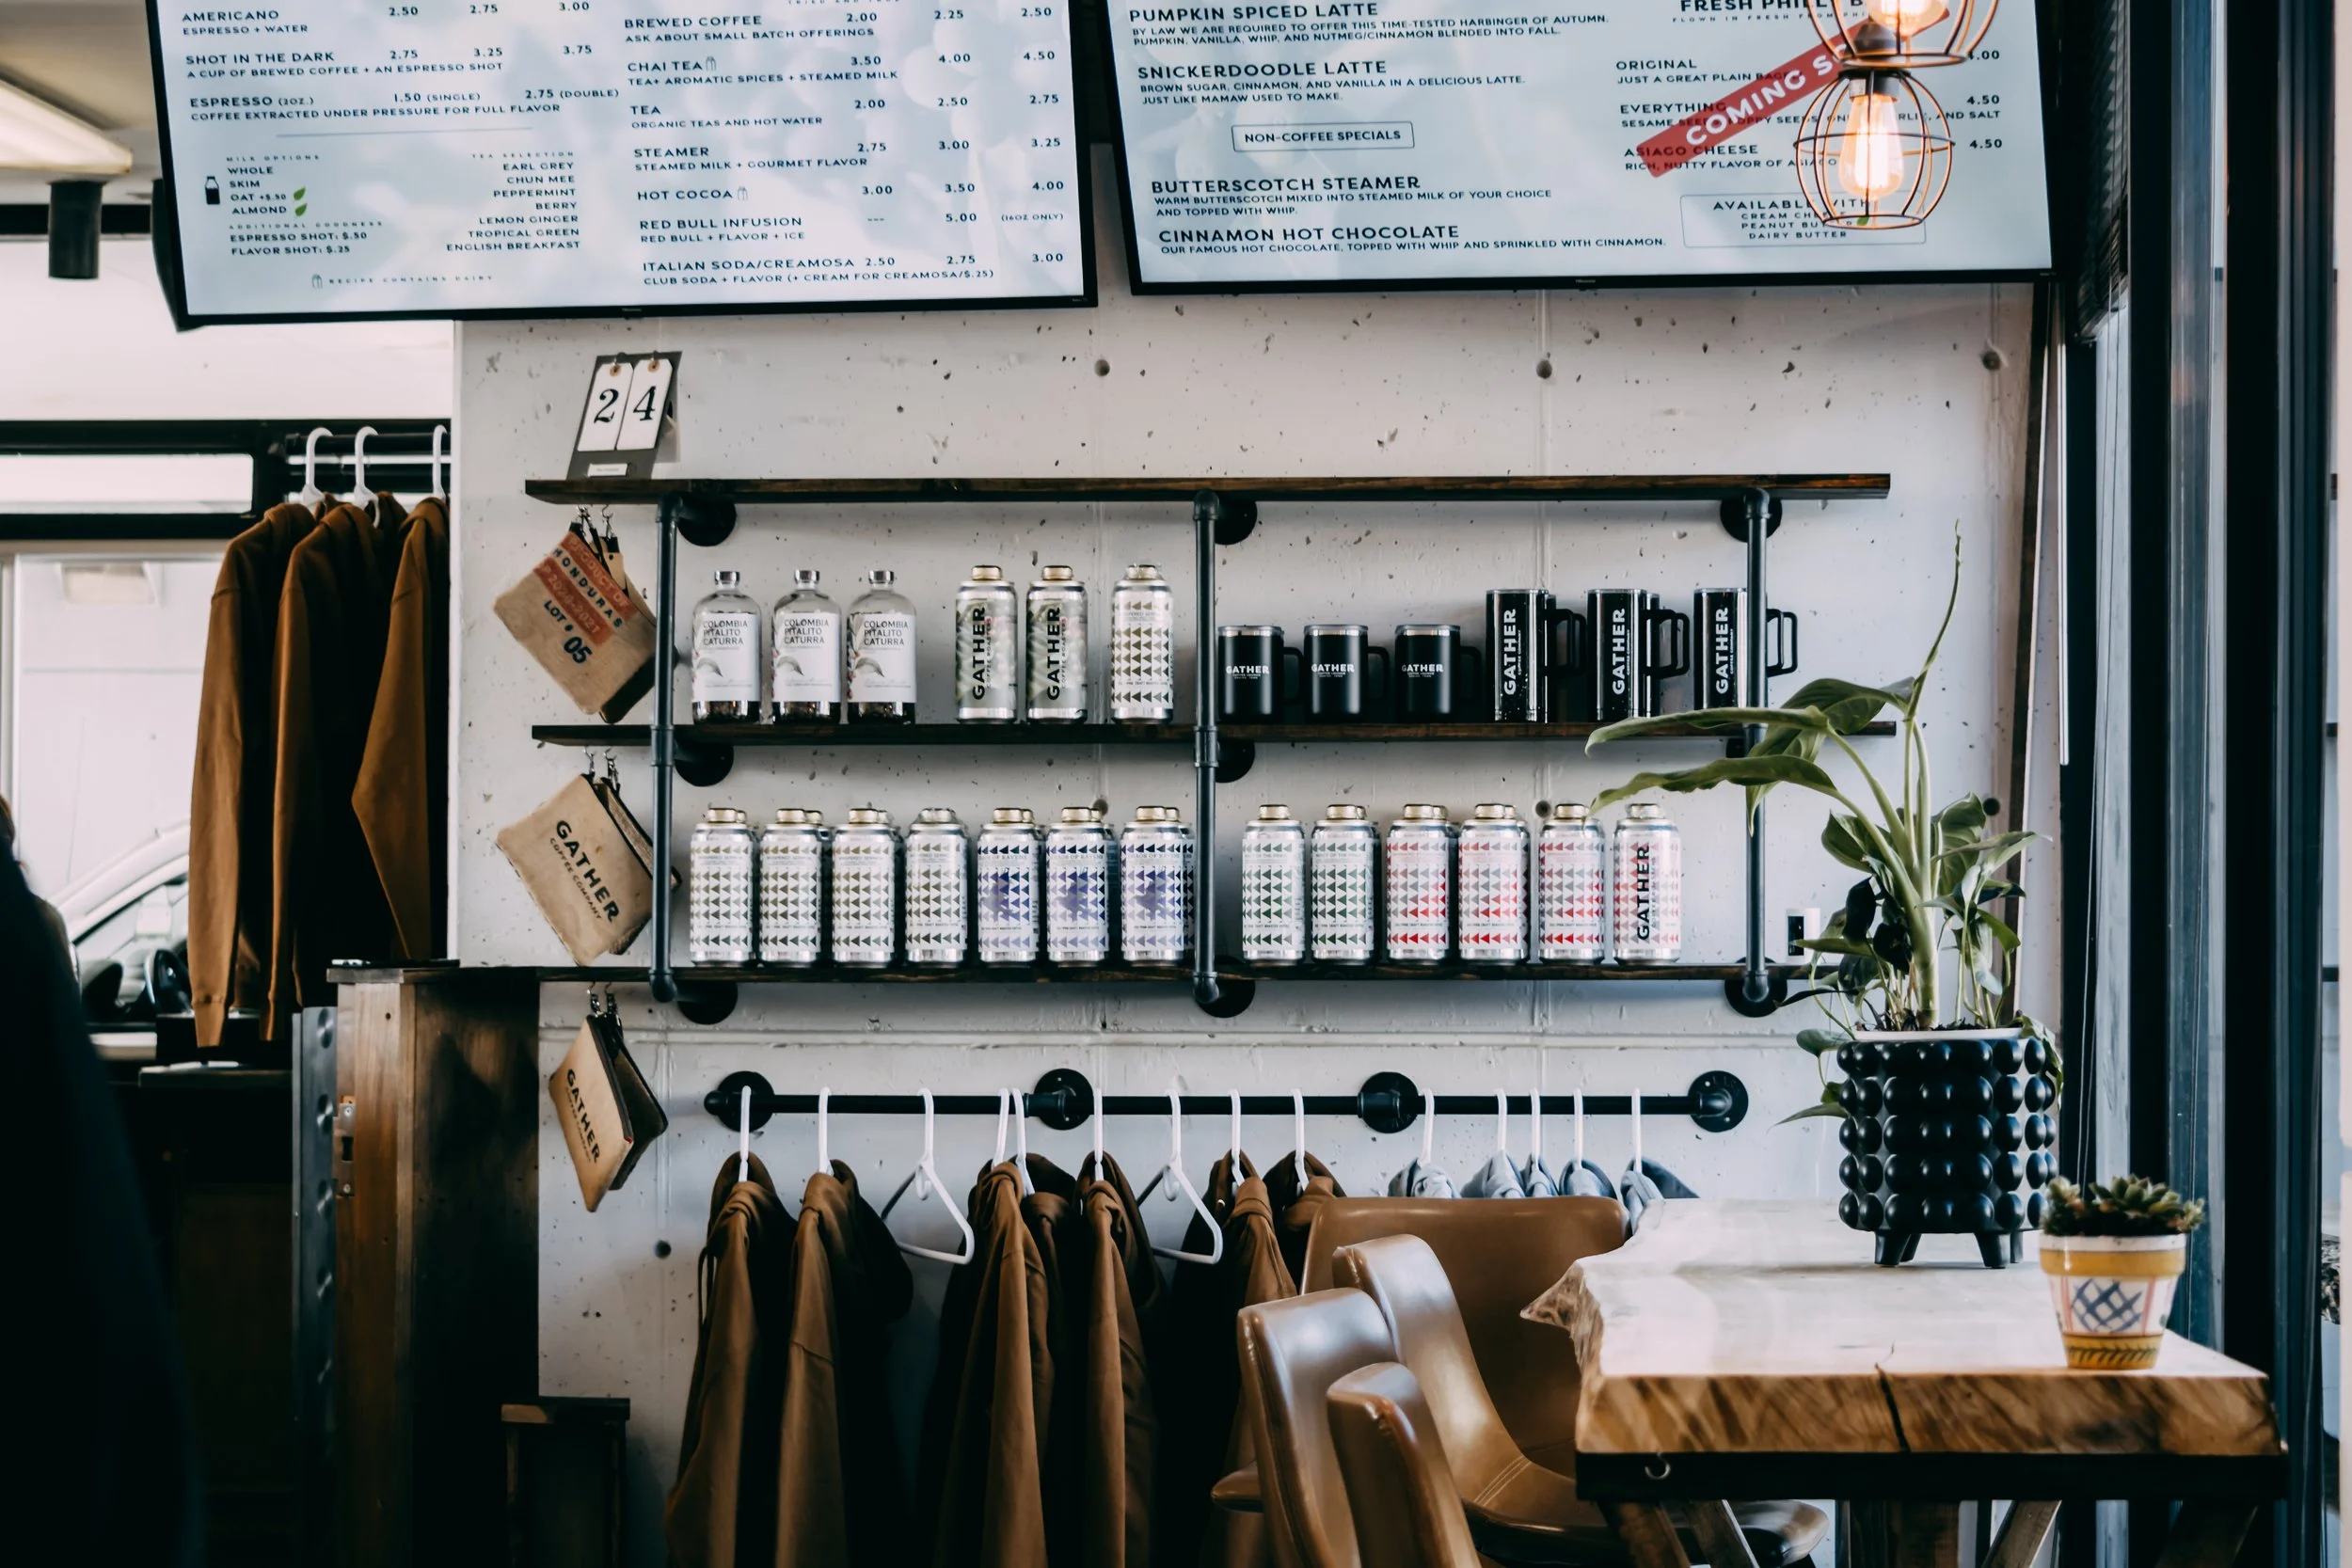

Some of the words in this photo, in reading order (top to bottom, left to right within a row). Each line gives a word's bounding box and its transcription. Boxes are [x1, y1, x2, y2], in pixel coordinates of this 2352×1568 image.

[181, 8, 279, 22] AMERICANO
[388, 5, 419, 17] 2.50
[469, 3, 499, 14] 2.75
[559, 0, 590, 11] 3.00
[1128, 6, 1225, 23] PUMPKIN
[1232, 4, 1308, 20] SPICED
[1314, 1, 1378, 17] LATTE
[1680, 0, 1754, 12] FRESH
[623, 16, 692, 29] BREWED
[697, 14, 762, 26] COFFEE
[845, 11, 878, 23] 2.00
[933, 8, 964, 20] 2.25
[1021, 6, 1052, 17] 2.50
[625, 34, 651, 42] ASK
[654, 32, 699, 42] ABOUT
[703, 31, 748, 40] SMALL
[751, 29, 795, 40] BATCH
[798, 27, 874, 38] OFFERINGS
[184, 54, 227, 65] SHOT
[232, 53, 250, 64] IN
[254, 52, 286, 63] THE
[291, 51, 335, 62] DARK
[389, 48, 419, 60] 2.75
[473, 46, 503, 57] 3.25
[563, 43, 593, 55] 3.75
[627, 60, 666, 72] CHAI
[670, 59, 703, 71] TEA
[850, 55, 882, 66] 3.50
[937, 52, 971, 64] 4.00
[1022, 50, 1056, 61] 4.50
[1136, 61, 1316, 80] SNICKERDOODLE
[1323, 59, 1387, 75] LATTE
[1614, 57, 1697, 71] ORIGINAL
[1616, 74, 1648, 85] JUST
[1665, 72, 1708, 83] GREAT
[1711, 71, 1752, 82] PLAIN
[189, 96, 273, 107] ESPRESSO
[393, 91, 421, 103] 1.50
[425, 91, 481, 103] (SINGLE)
[524, 87, 554, 100] 2.75
[558, 87, 619, 99] (DOUBLE)
[629, 104, 661, 116] TEA
[853, 98, 885, 109] 2.00
[937, 96, 968, 107] 2.50
[1028, 92, 1059, 104] 2.75
[1141, 95, 1169, 104] JUST
[1172, 94, 1196, 104] LIKE
[1200, 93, 1248, 103] MAMAW
[1251, 92, 1283, 103] USED
[1286, 92, 1303, 102] TO
[1619, 103, 1727, 115] EVERYTHING
[1965, 93, 2000, 105] 4.50
[190, 111, 240, 121] COFFEE
[244, 109, 320, 120] EXTRACTED
[323, 107, 368, 118] UNDER
[372, 106, 439, 117] PRESSURE
[443, 105, 469, 115] FOR
[473, 104, 504, 114] FULL
[509, 103, 561, 113] FLAVOR
[1686, 70, 1806, 146] COMING
[1621, 119, 1675, 128] SESAME
[1968, 110, 2001, 120] SALT
[1244, 131, 1334, 143] NON-COFFEE
[1336, 129, 1401, 141] SPECIALS
[632, 146, 709, 158] STEAMER
[856, 141, 886, 152] 2.75
[938, 139, 970, 150] 3.00
[1030, 136, 1061, 148] 3.25
[1692, 144, 1759, 156] CHEESE
[1968, 137, 2003, 150] 4.50
[226, 165, 273, 175] WHOLE
[501, 162, 534, 171] EARL
[539, 161, 574, 170] GREY
[1710, 159, 1762, 169] FLAVOR
[1766, 159, 1783, 168] OF
[228, 179, 261, 189] SKIM
[505, 175, 544, 184] CHUN
[547, 174, 575, 183] MEE
[1150, 177, 1314, 194] BUTTERSCOTCH
[1321, 175, 1421, 190] STEAMER
[492, 187, 575, 198] PEPPERMINT
[636, 189, 670, 201] HOT
[675, 188, 733, 200] COCOA
[862, 184, 893, 196] 3.00
[944, 182, 976, 193] 3.50
[1031, 180, 1064, 191] 4.00
[230, 205, 287, 214] ALMOND
[534, 200, 577, 211] BERRY
[1155, 207, 1182, 217] AND
[1184, 206, 1230, 216] TOPPED
[1232, 206, 1263, 215] WITH
[639, 218, 672, 230] RED
[675, 217, 718, 230] BULL
[723, 216, 802, 228] INFUSION
[945, 212, 977, 223] 5.00
[1740, 212, 1788, 220] CREAM
[1157, 228, 1274, 243] CINNAMON
[1281, 227, 1325, 241] HOT
[1330, 224, 1459, 240] CHOCOLATE
[1740, 222, 1795, 230] PEANUT
[1748, 231, 1789, 240] DAIRY
[1795, 230, 1848, 240] BUTTER
[445, 242, 502, 251] ENGLISH
[505, 240, 580, 250] BREAKFAST
[642, 260, 706, 272] ITALIAN
[710, 257, 854, 270] SODA/CREAMOSA
[865, 256, 896, 267] 2.50
[946, 254, 976, 264] 2.75
[1031, 251, 1063, 262] 3.00
[553, 548, 623, 627] HONDURAS
[544, 600, 566, 622] LOT
[564, 636, 593, 663] 05
[703, 619, 748, 628] COLOMBIA
[784, 619, 830, 628] COLOMBIA
[864, 620, 909, 629] COLOMBIA
[703, 637, 744, 646] CATURRA
[784, 636, 825, 645] CATURRA
[864, 637, 905, 646] CATURRA
[972, 607, 986, 701] GATHER
[1047, 607, 1060, 701] GATHER
[1503, 609, 1517, 695] GATHER
[1612, 608, 1626, 695] GATHER
[1715, 607, 1728, 694] GATHER
[1225, 665, 1270, 674] GATHER
[1311, 663, 1356, 673] GATHER
[1401, 663, 1444, 673] GATHER
[556, 820, 620, 923] GATHER
[1636, 845, 1650, 941] GATHER
[566, 1069, 600, 1164] GATHER
